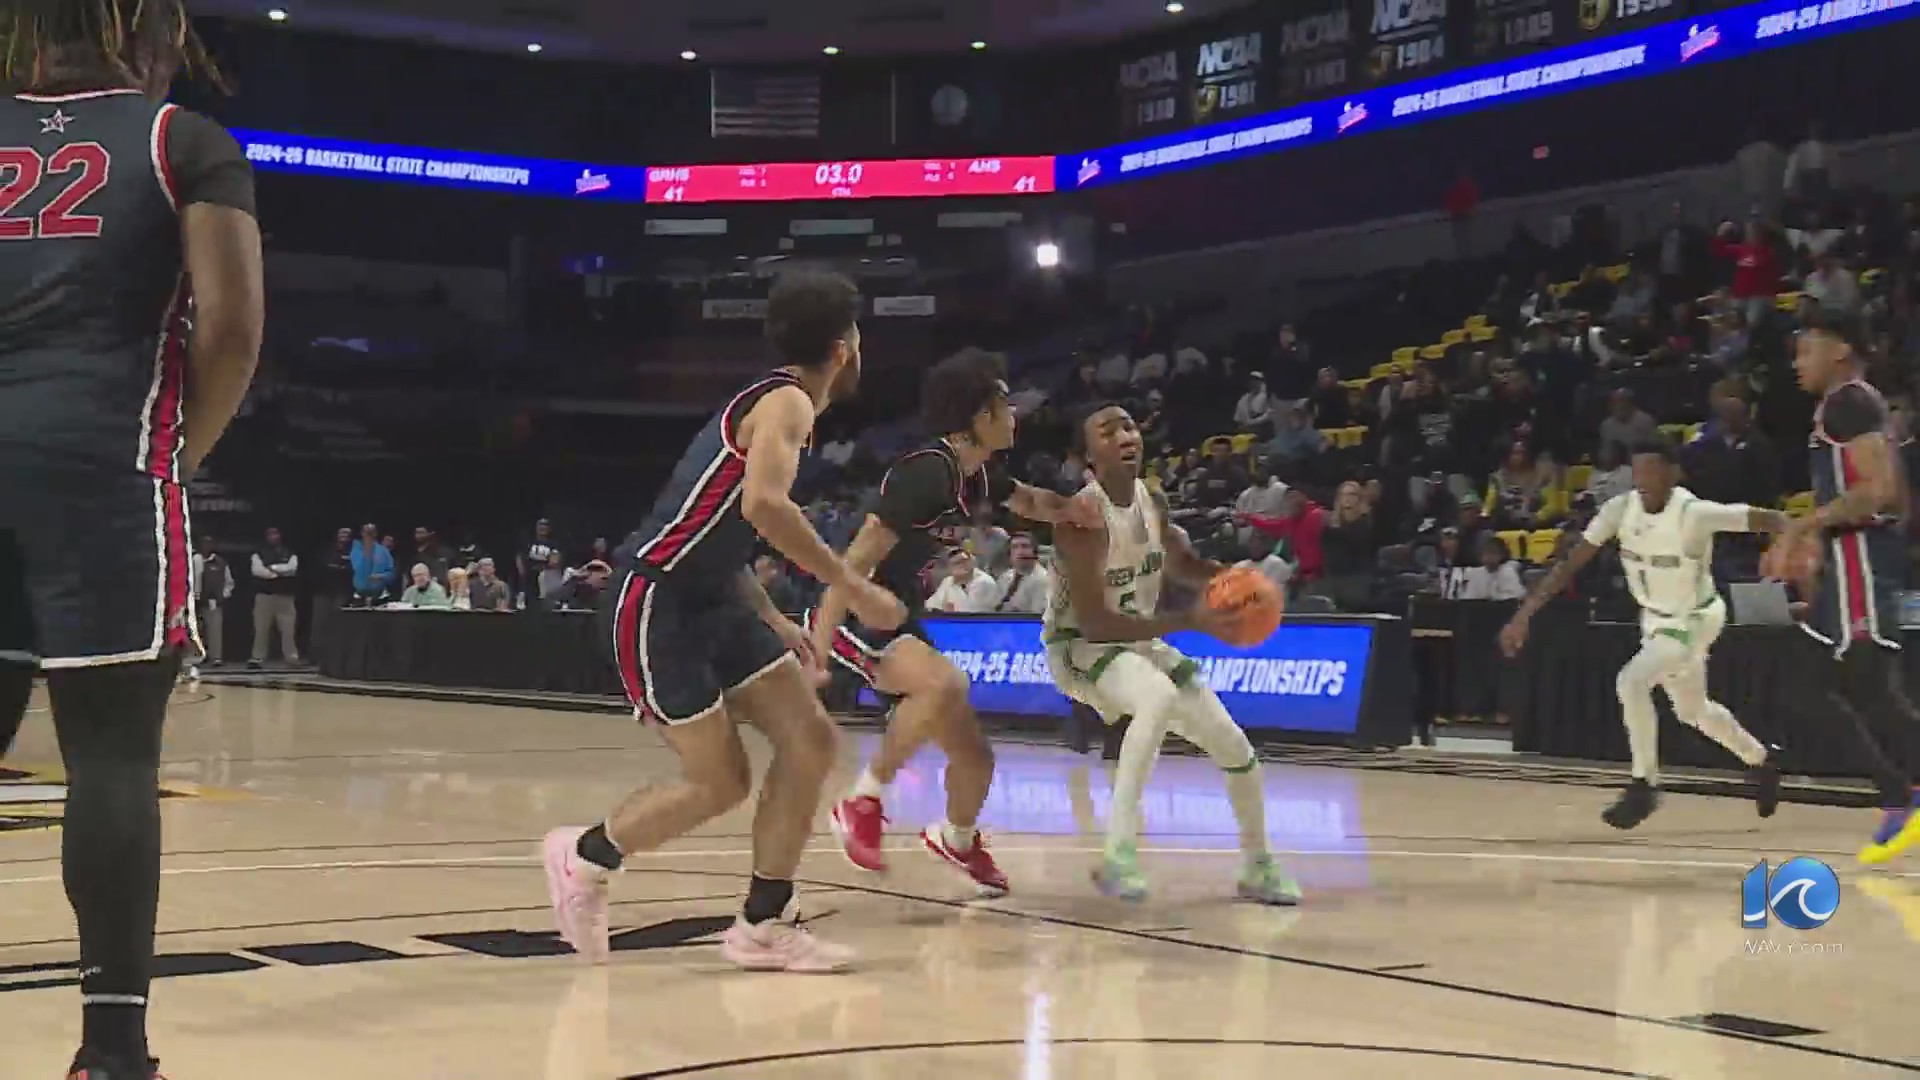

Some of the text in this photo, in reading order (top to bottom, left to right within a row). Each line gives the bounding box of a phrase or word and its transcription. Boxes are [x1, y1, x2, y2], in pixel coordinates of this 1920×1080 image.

[1197, 33, 1262, 76] NCAA
[246, 143, 530, 186] 2024-25 BASKETBALL STATE CHAMPIONSHIPS
[815, 163, 863, 185] 03.0
[1013, 175, 1036, 192] 41
[0, 141, 110, 240] 22
[663, 186, 684, 202] 41
[942, 650, 1009, 683] 024-25
[1197, 657, 1348, 697] AMPIONSHIPS
